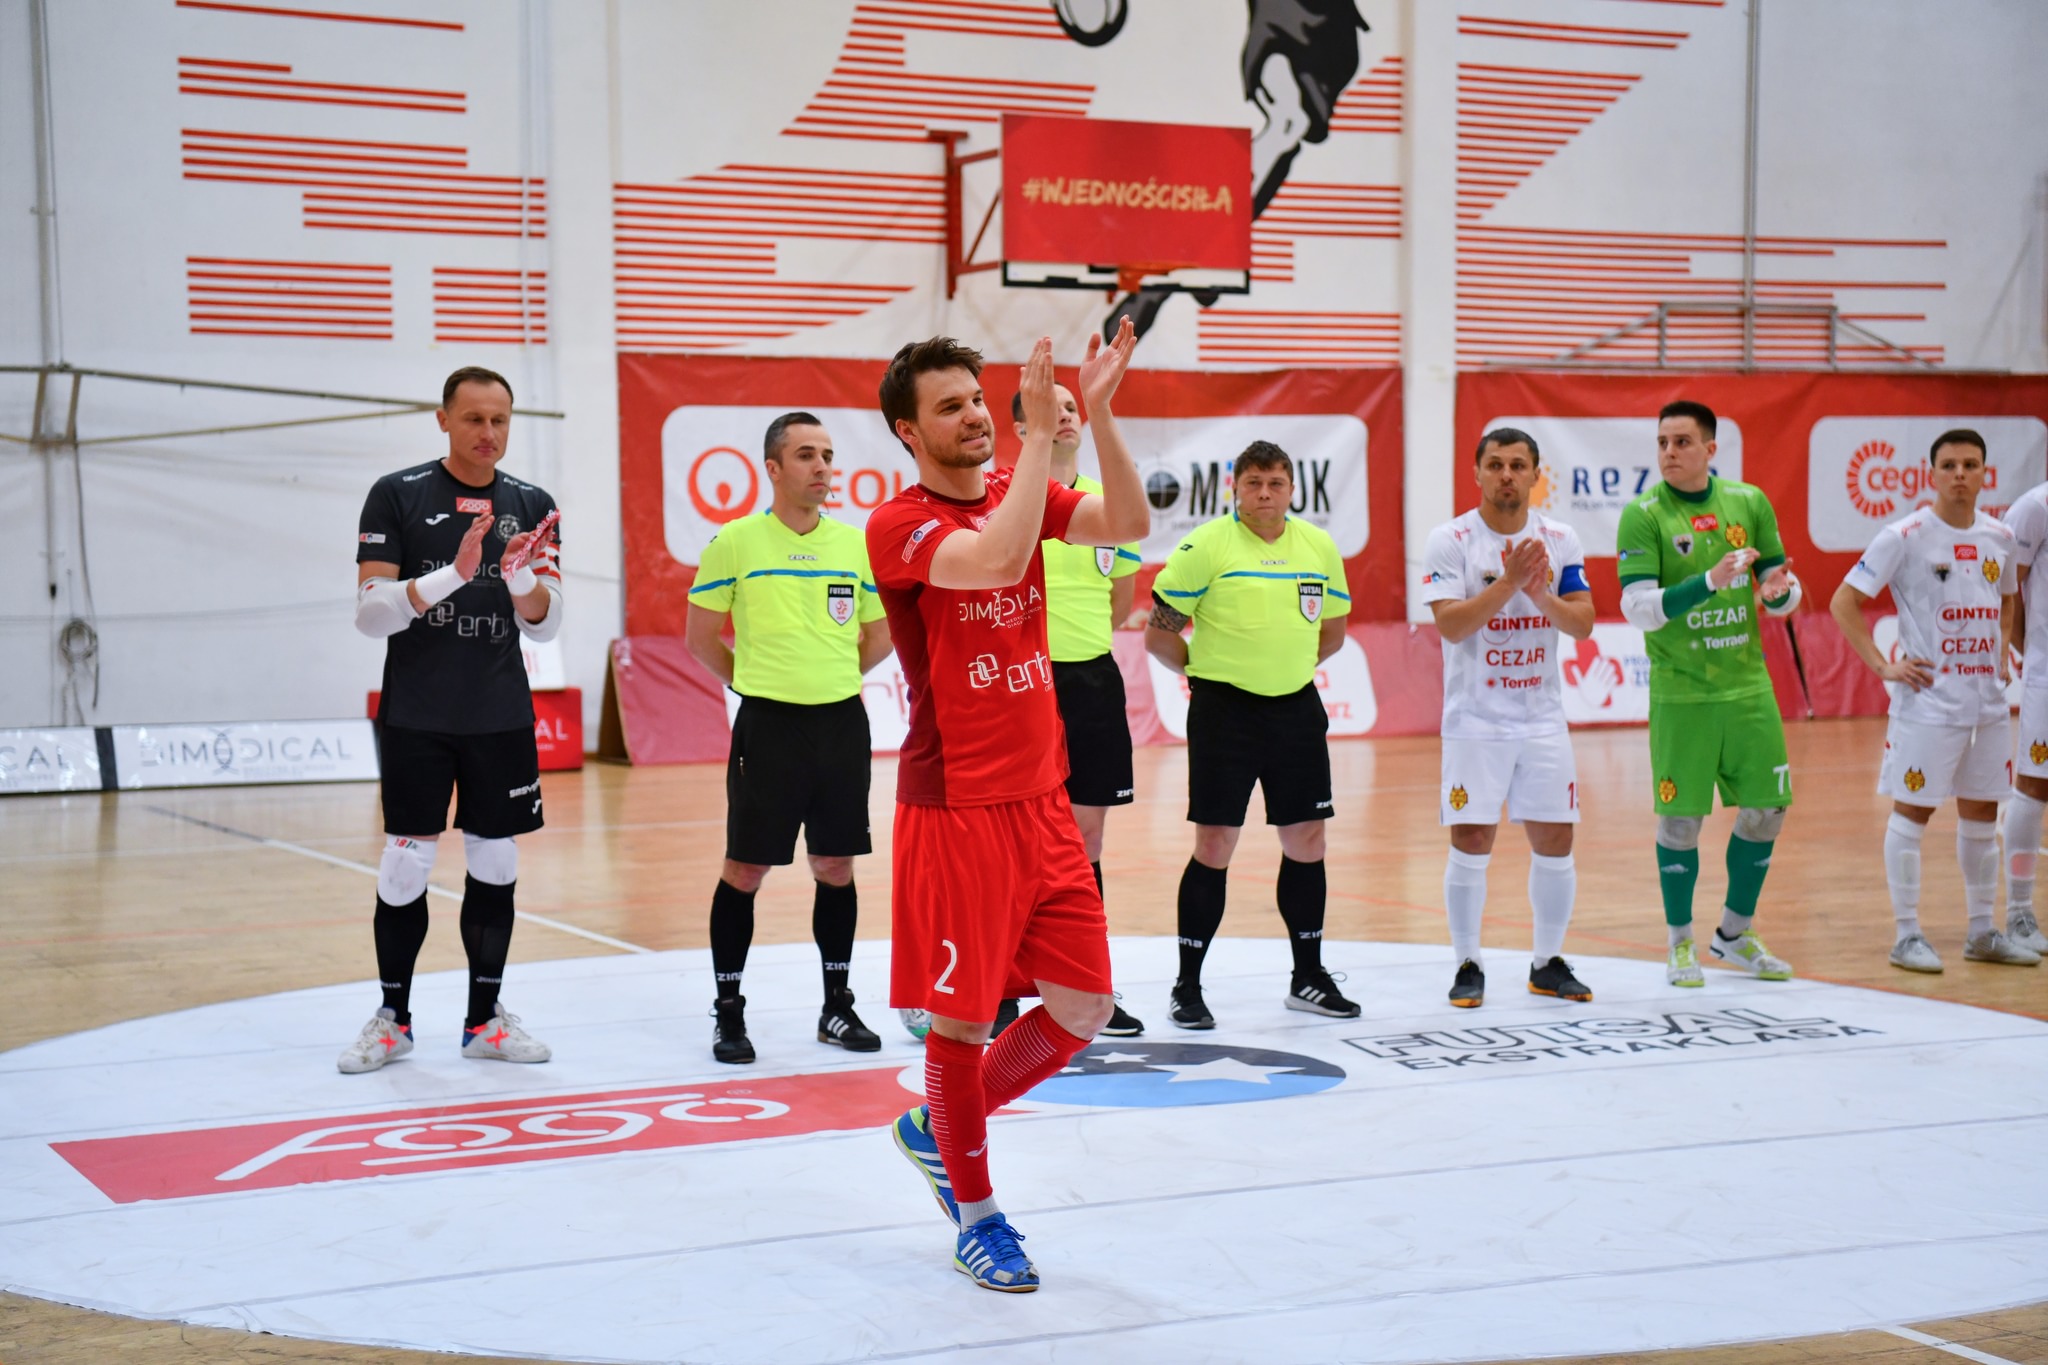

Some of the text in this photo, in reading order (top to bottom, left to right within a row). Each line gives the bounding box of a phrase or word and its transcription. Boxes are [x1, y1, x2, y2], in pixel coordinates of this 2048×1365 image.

[1021, 176, 1233, 216] #WJEDNOŚCISIŁA
[1686, 605, 1748, 629] CEZAR
[1485, 647, 1545, 667] CEZAR
[933, 939, 958, 995] 2
[1340, 1007, 1834, 1059] FUTSAL
[1394, 1025, 1887, 1071] EKSTRAKLASA
